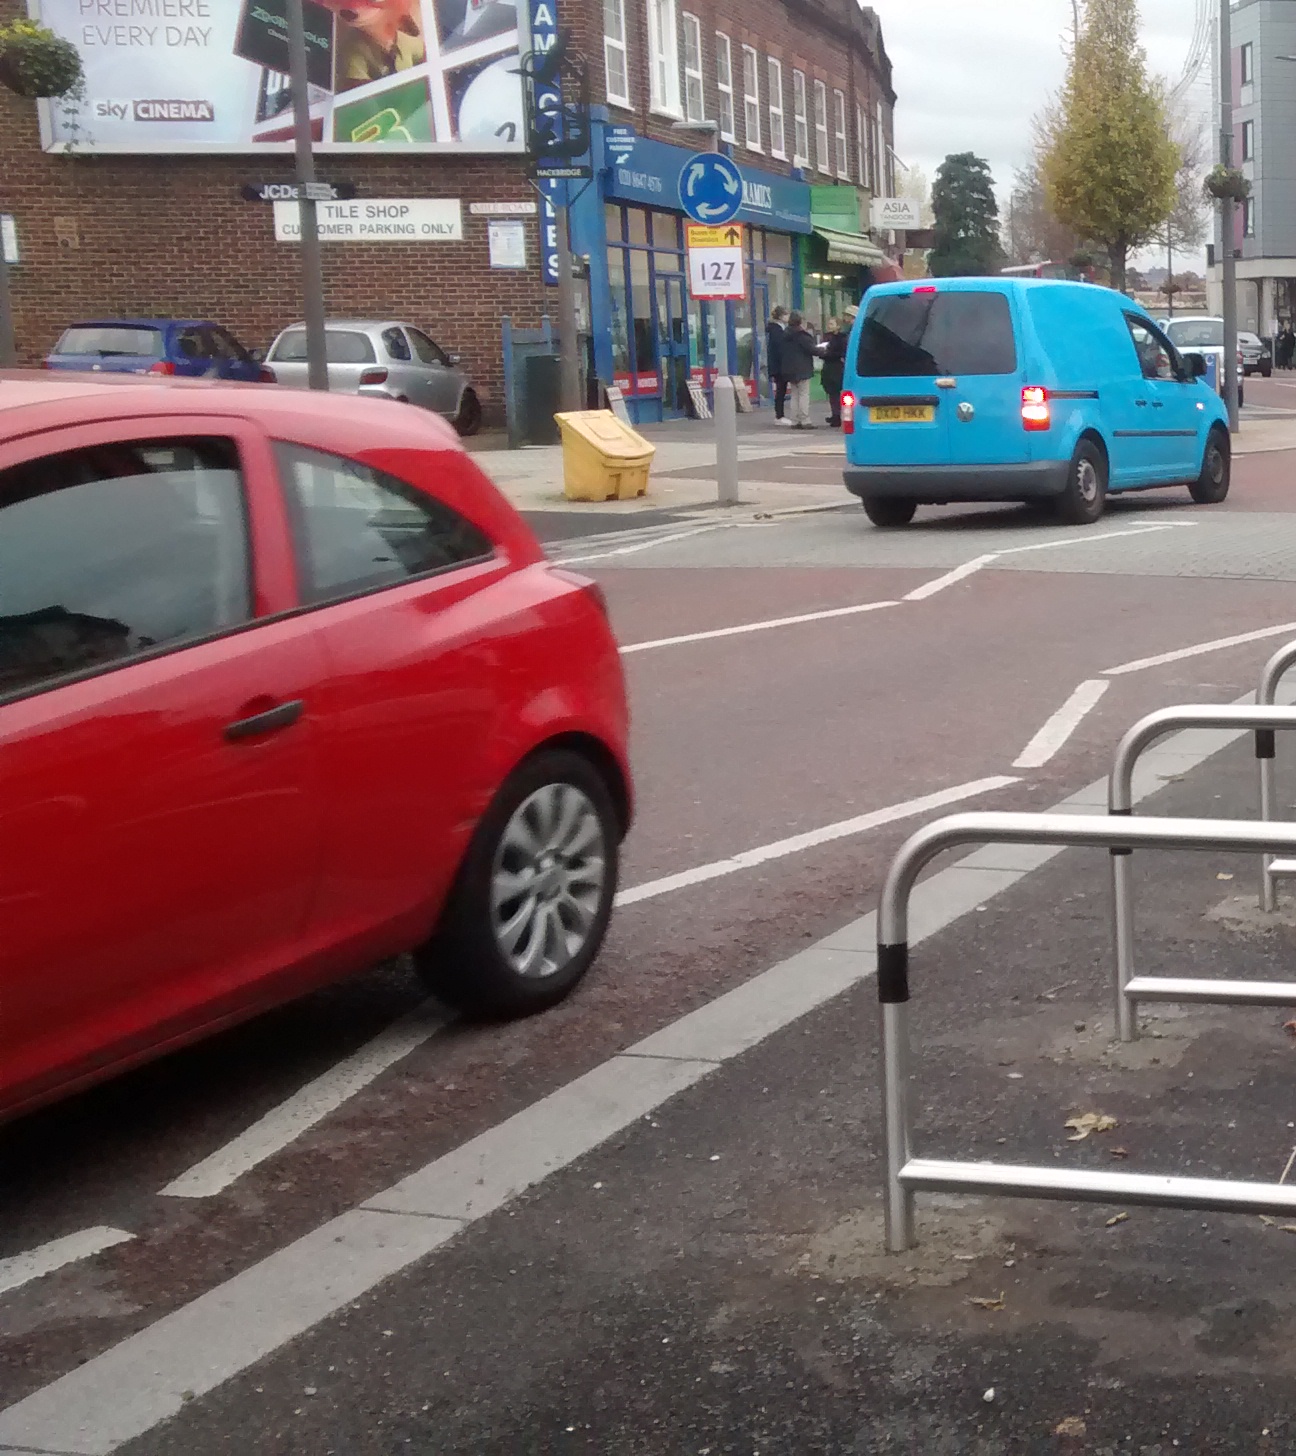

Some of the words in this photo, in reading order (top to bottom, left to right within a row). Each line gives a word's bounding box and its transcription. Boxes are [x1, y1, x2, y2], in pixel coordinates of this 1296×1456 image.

[79, 0, 211, 17] PREMIERE
[82, 25, 158, 46] EVERY
[165, 26, 212, 46] DAY
[96, 100, 129, 120] sky
[136, 103, 211, 119] CINEMA
[536, 168, 582, 177] HACKBRIDGE
[259, 184, 338, 199] JCDex
[325, 205, 359, 218] TILE
[365, 205, 410, 218] SHOP
[882, 203, 910, 213] ASIA
[282, 223, 354, 235] CUOMER
[359, 223, 416, 235] PARKING
[421, 223, 455, 235] ONLY
[701, 261, 736, 281] 127
